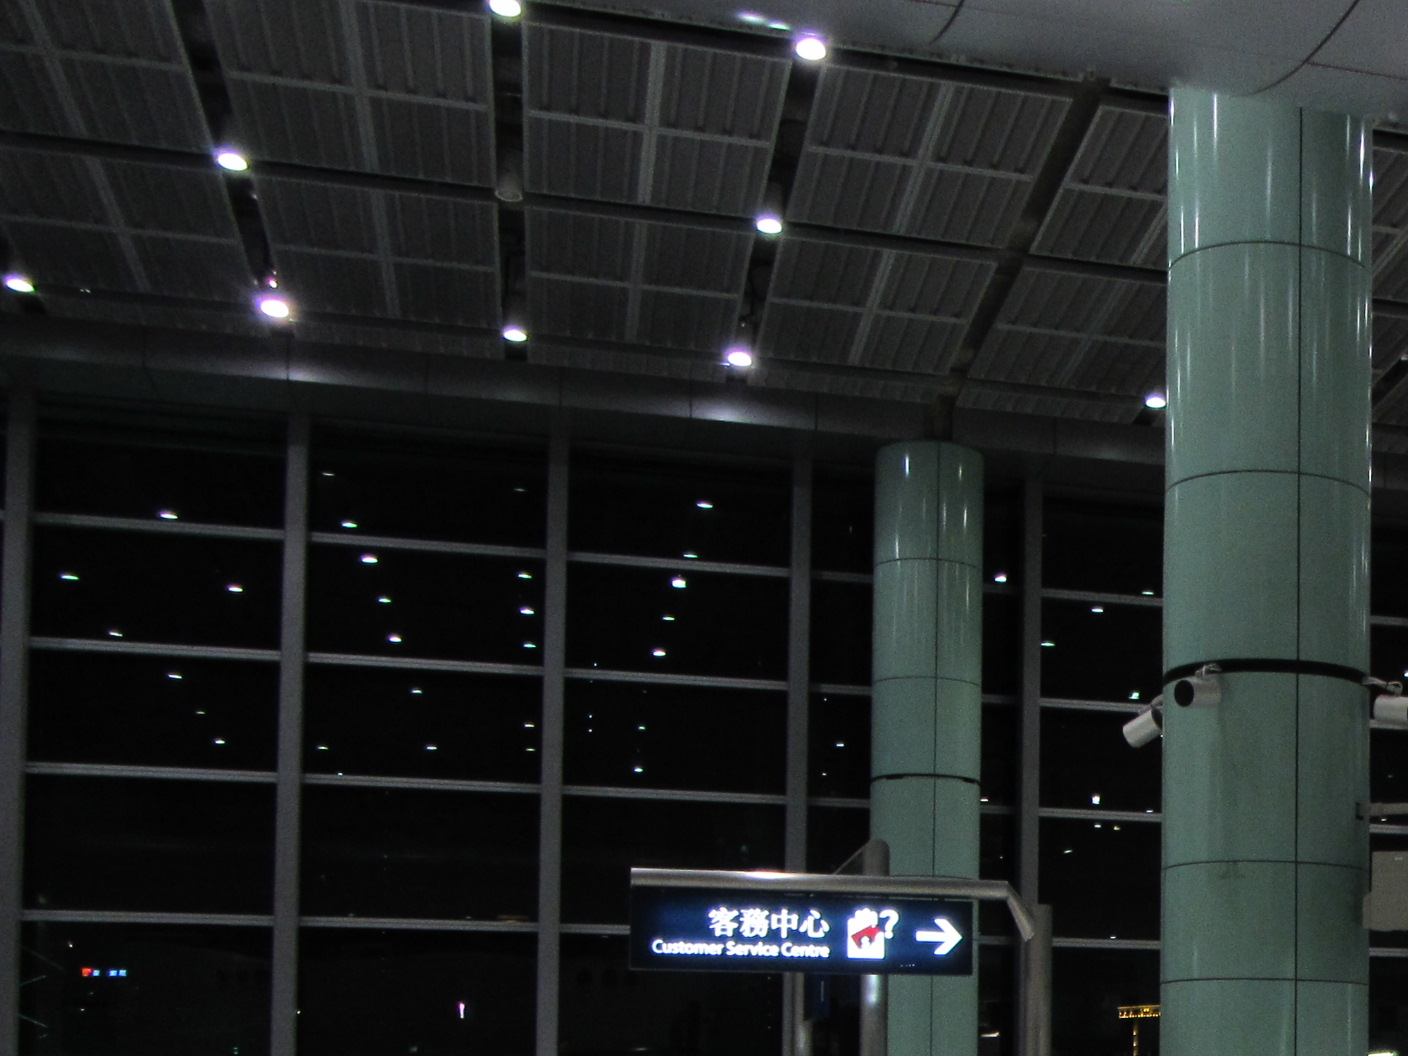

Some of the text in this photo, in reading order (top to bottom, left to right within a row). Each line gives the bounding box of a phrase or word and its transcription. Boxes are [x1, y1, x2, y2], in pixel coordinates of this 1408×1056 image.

[707, 907, 830, 938] 客務中心
[651, 939, 831, 959] Customer Service Centre
